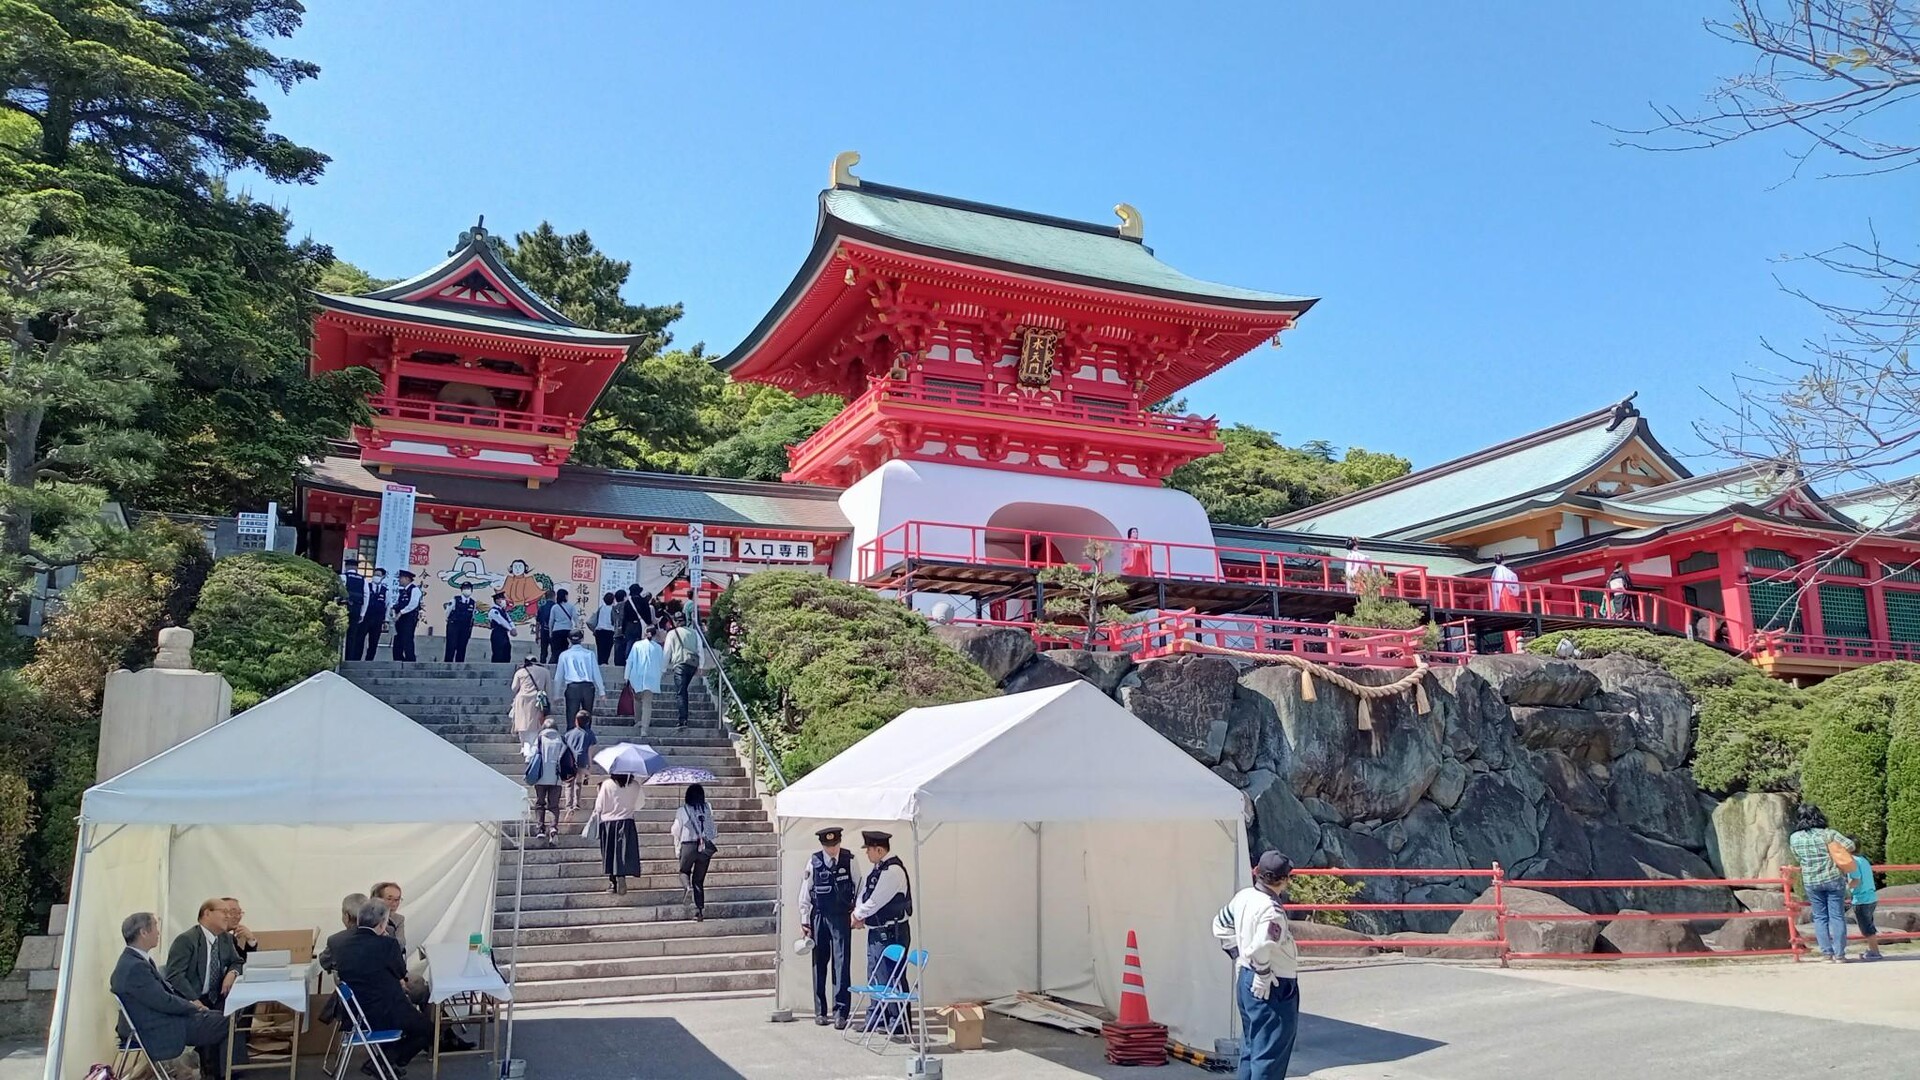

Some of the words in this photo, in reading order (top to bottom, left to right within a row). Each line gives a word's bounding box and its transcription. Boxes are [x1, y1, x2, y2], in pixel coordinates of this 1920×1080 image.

[1029, 338, 1044, 374] 水天門
[667, 538, 715, 553] 入口
[691, 526, 701, 565] 入口専用
[743, 541, 808, 559] 入口専用
